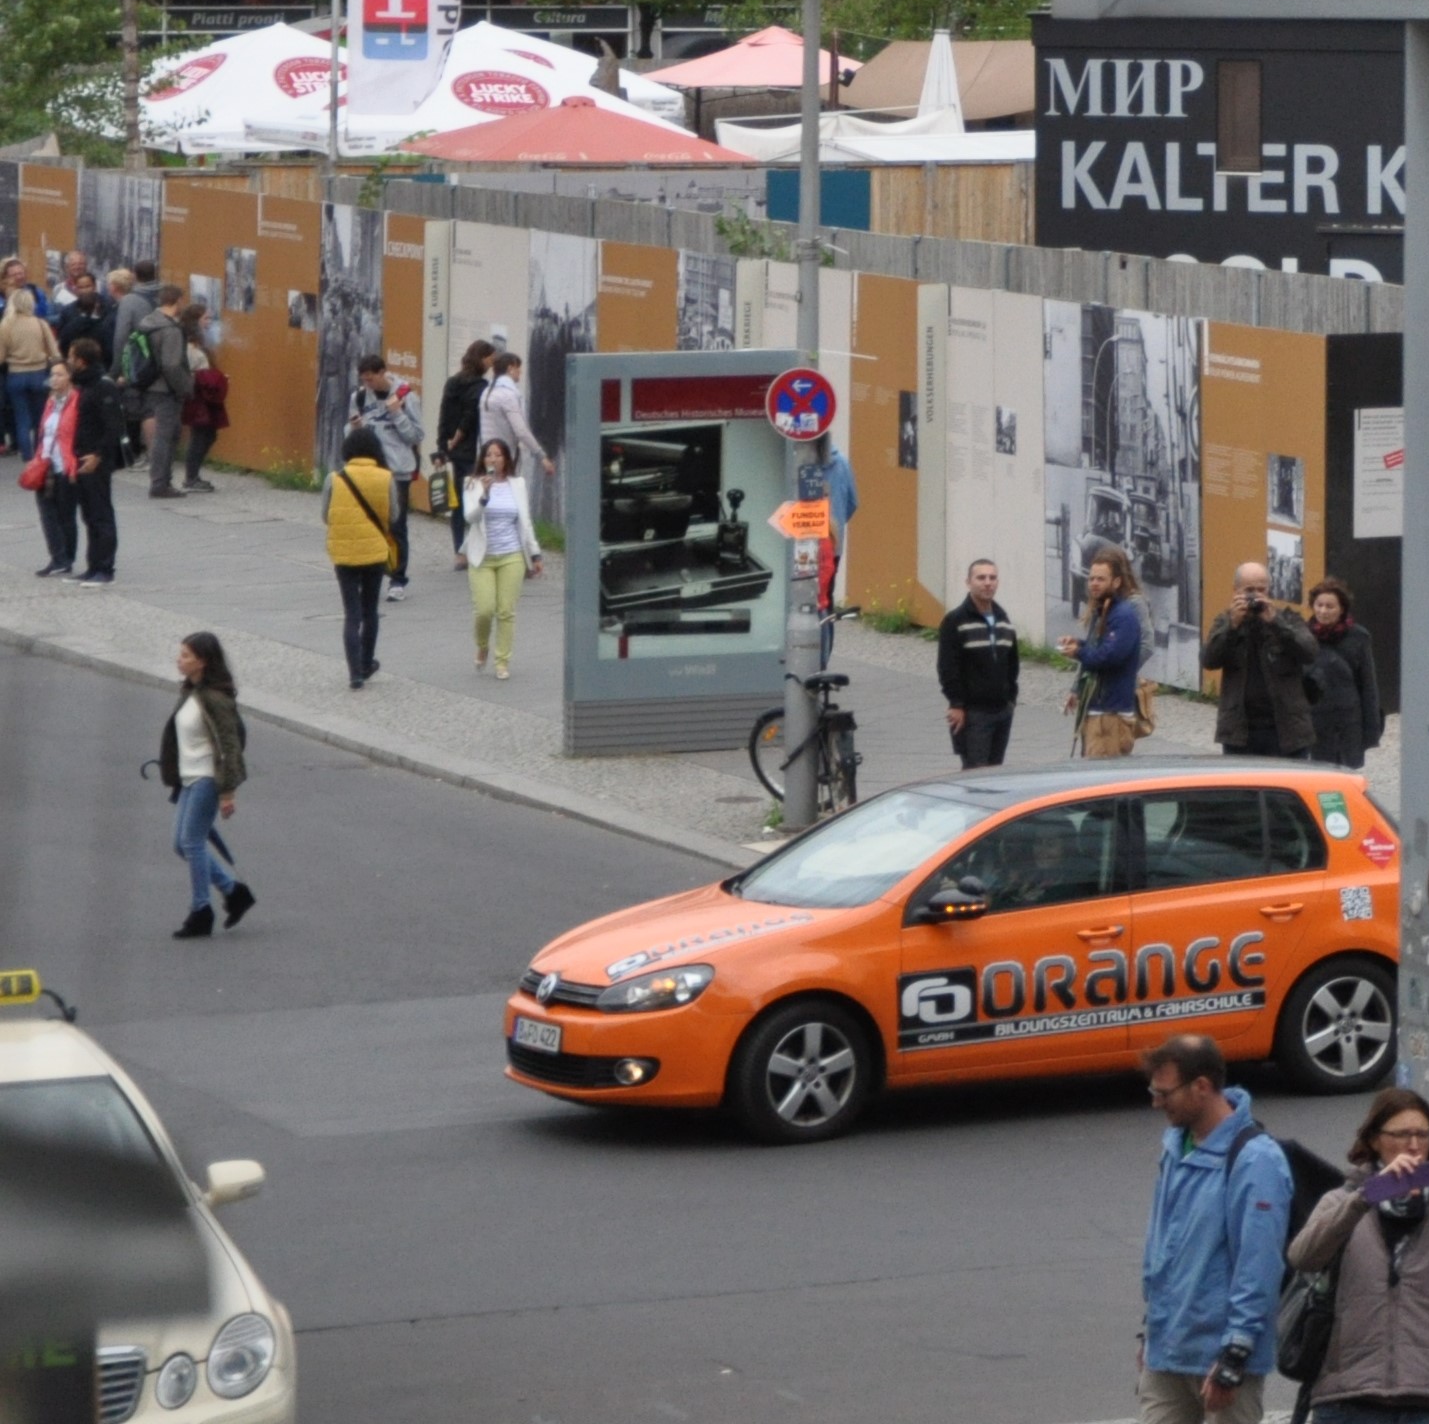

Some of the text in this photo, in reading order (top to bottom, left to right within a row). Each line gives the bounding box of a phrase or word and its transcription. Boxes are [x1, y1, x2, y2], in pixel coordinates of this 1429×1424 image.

[191, 12, 235, 26] Piatti
[469, 82, 527, 94] LUCKY
[1044, 58, 1204, 118] МИР
[470, 92, 535, 104] STRIKE
[994, 1007, 1143, 1037] BILDUNGSZENTRUM
